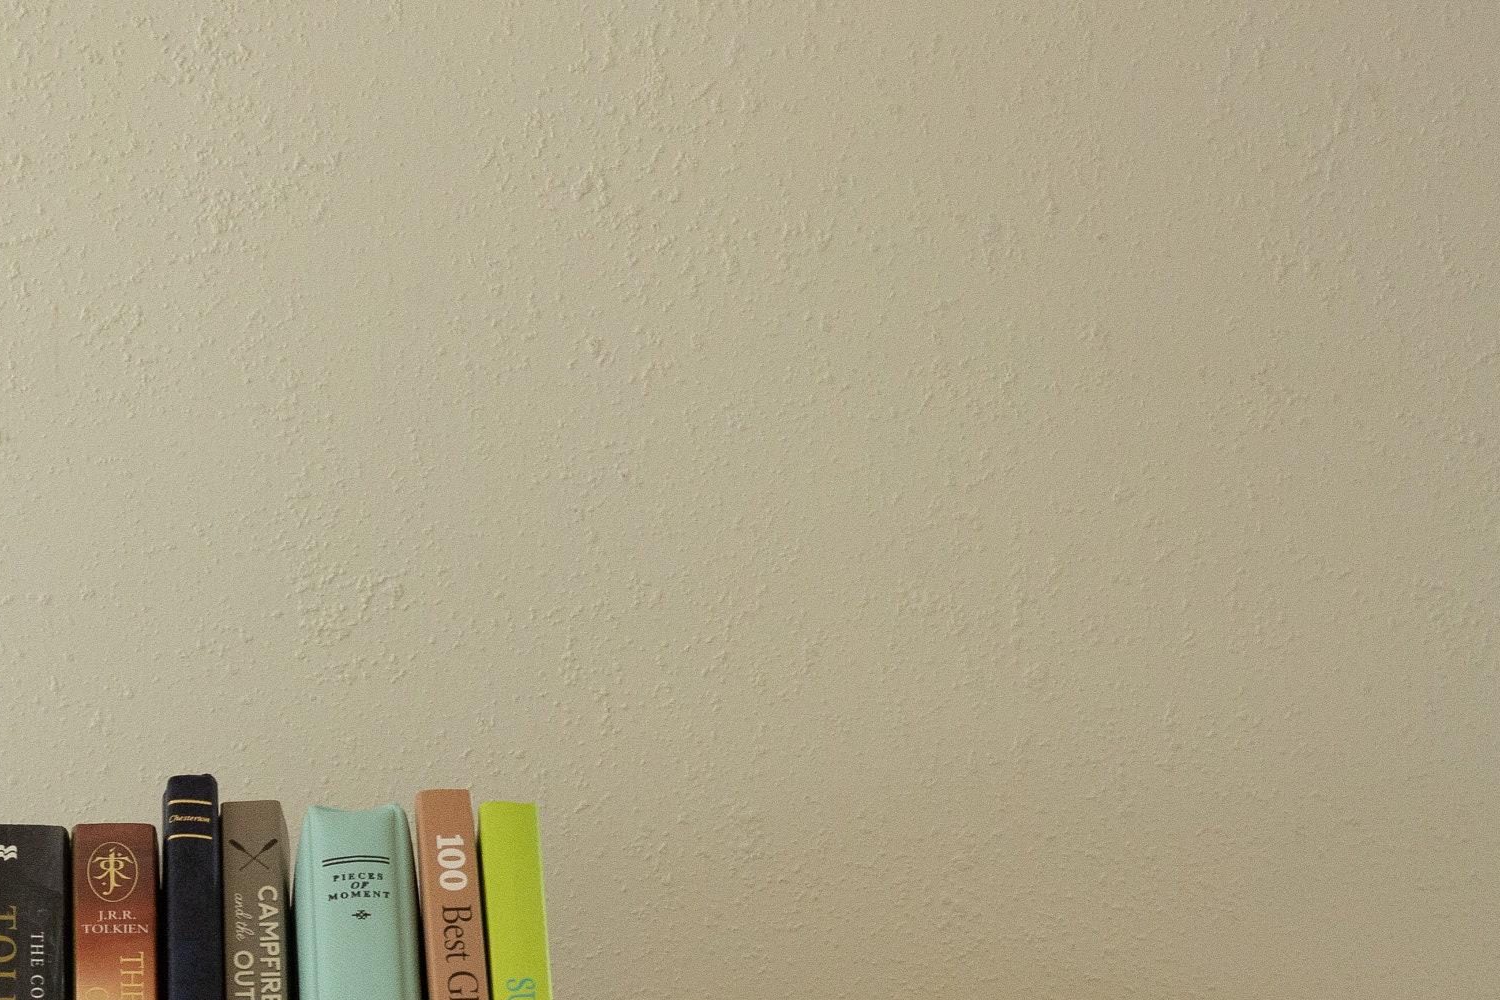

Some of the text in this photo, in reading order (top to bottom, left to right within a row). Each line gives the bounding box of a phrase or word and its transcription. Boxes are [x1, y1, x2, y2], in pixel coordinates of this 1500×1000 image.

[168, 814, 211, 824] Chesterton
[436, 834, 469, 892] 100
[332, 872, 384, 882] PIECES
[350, 881, 369, 890] OF
[328, 890, 391, 902] MOMENT
[234, 893, 252, 920] and
[96, 910, 137, 922] J.R.R.
[80, 923, 149, 935] TOLKIEN
[235, 921, 255, 942] the
[441, 904, 473, 963] Best
[31, 931, 44, 967] THE
